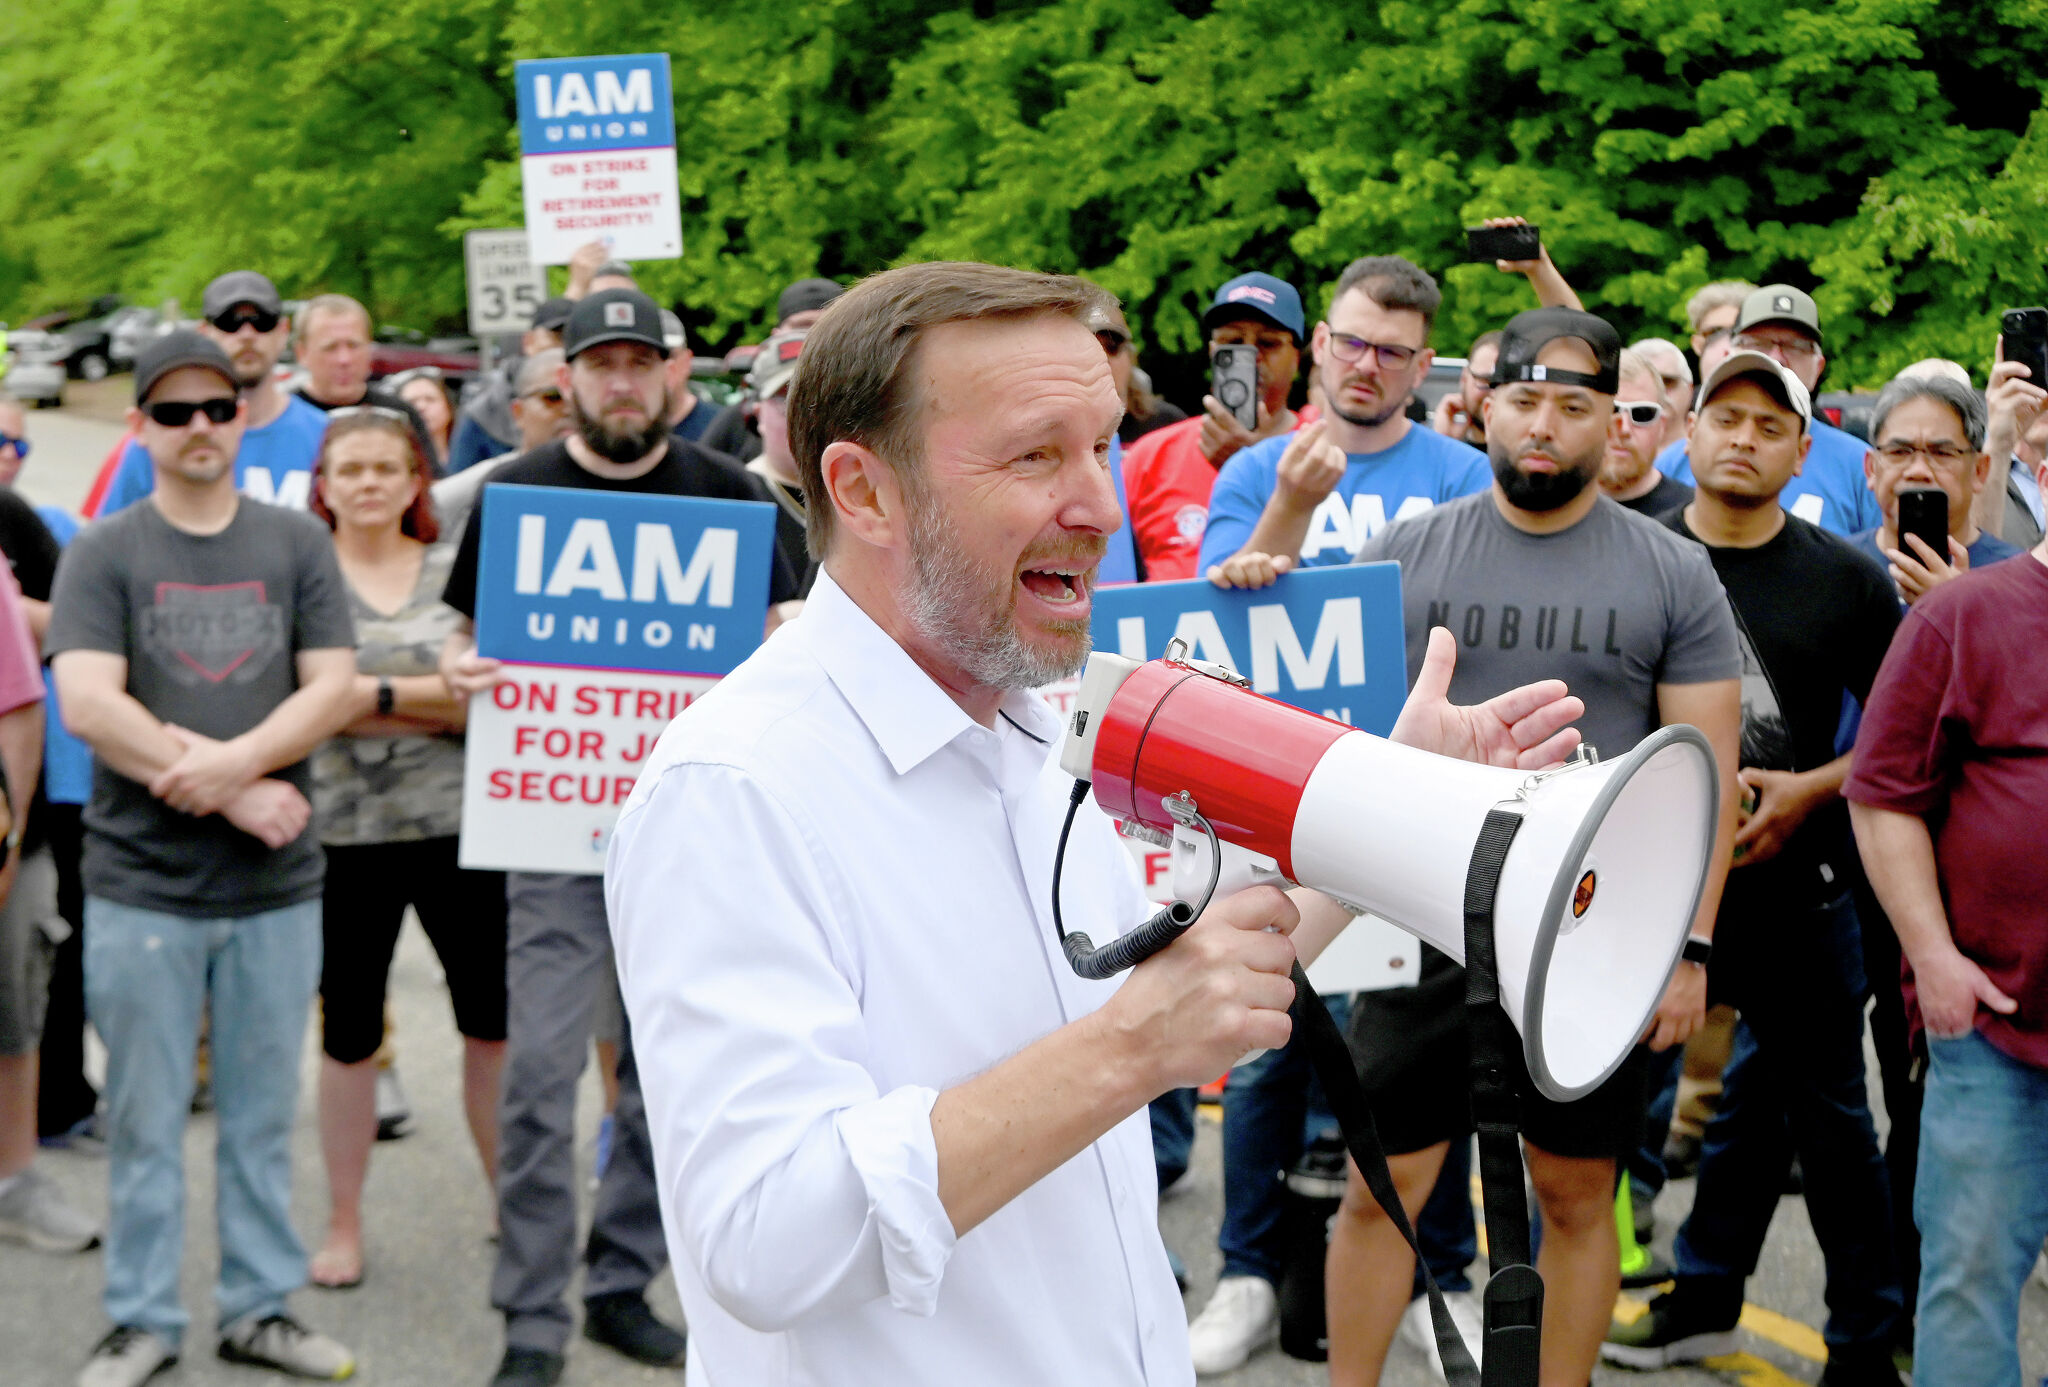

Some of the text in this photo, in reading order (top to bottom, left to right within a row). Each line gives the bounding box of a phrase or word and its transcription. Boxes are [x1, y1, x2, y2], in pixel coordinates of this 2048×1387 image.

[534, 69, 654, 118] IAM
[546, 120, 648, 142] UNION
[551, 158, 648, 176] ON STRIKE
[583, 178, 620, 191] FOR
[543, 193, 662, 212] RETIREMENT
[482, 285, 538, 320] 35
[1300, 491, 1434, 558] AM
[514, 513, 739, 608] IAM
[526, 612, 717, 651] UNION
[1117, 597, 1366, 694] IAM
[1427, 601, 1621, 655] NOBULL
[493, 681, 558, 713] ON
[515, 727, 605, 760] FOR
